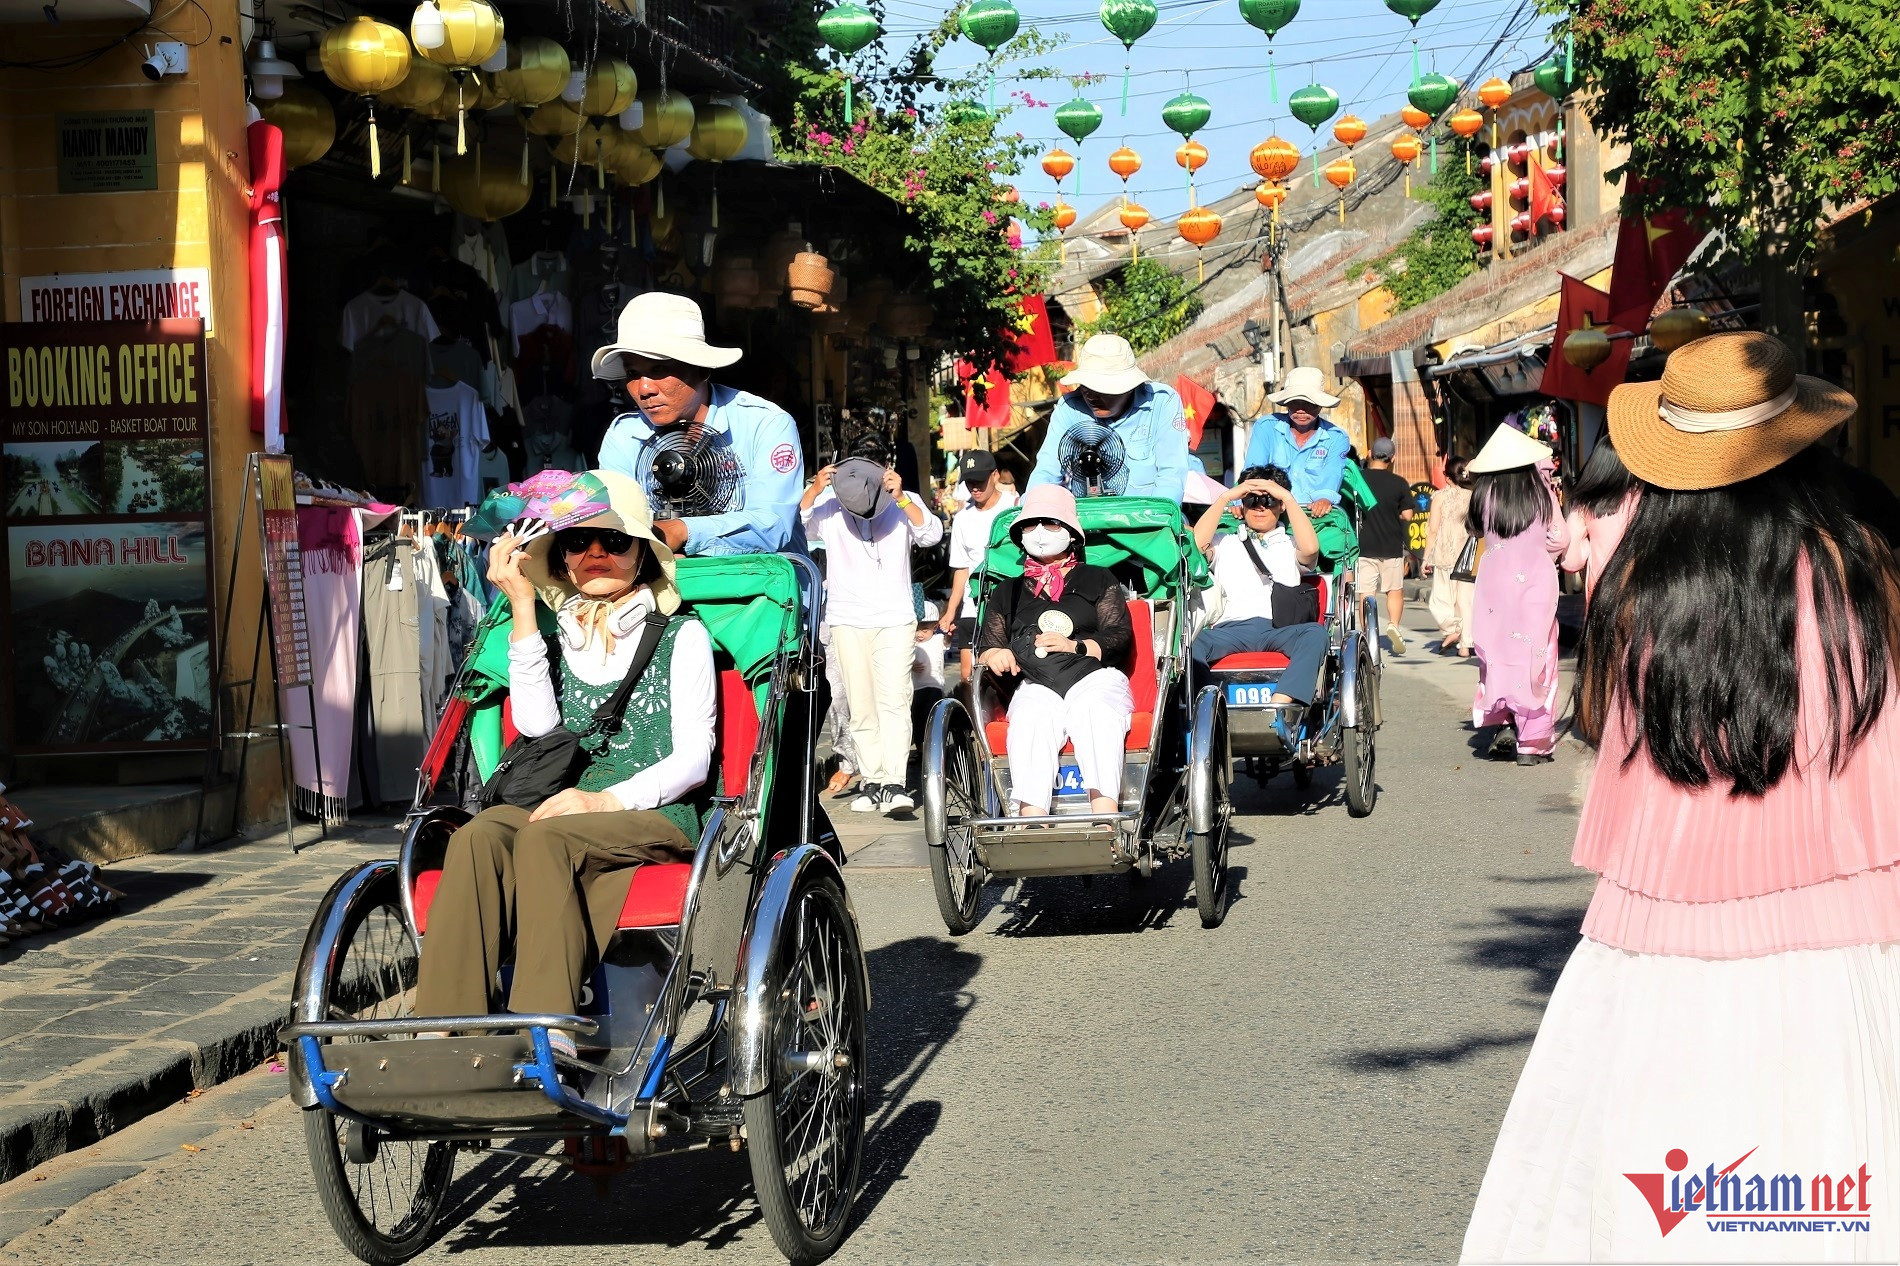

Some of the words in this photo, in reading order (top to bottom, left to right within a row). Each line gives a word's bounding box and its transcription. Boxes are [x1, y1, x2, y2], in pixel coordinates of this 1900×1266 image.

[63, 129, 101, 157] HANDY
[106, 127, 148, 156] MANDY
[31, 286, 104, 322] FOREIGN
[110, 282, 199, 321] EXCHANGE
[8, 345, 111, 407] BOOKING
[119, 343, 197, 405] OFFICE
[12, 422, 25, 436] MY
[28, 421, 49, 435] SON
[51, 420, 99, 434] HOLYLAND
[111, 418, 141, 433] BASKET
[144, 418, 167, 432] BOAT
[172, 417, 197, 431] TOUR
[26, 537, 115, 568] BANA
[120, 536, 188, 565] HILL
[1235, 687, 1271, 704] 098
[1053, 770, 1084, 790] 04
